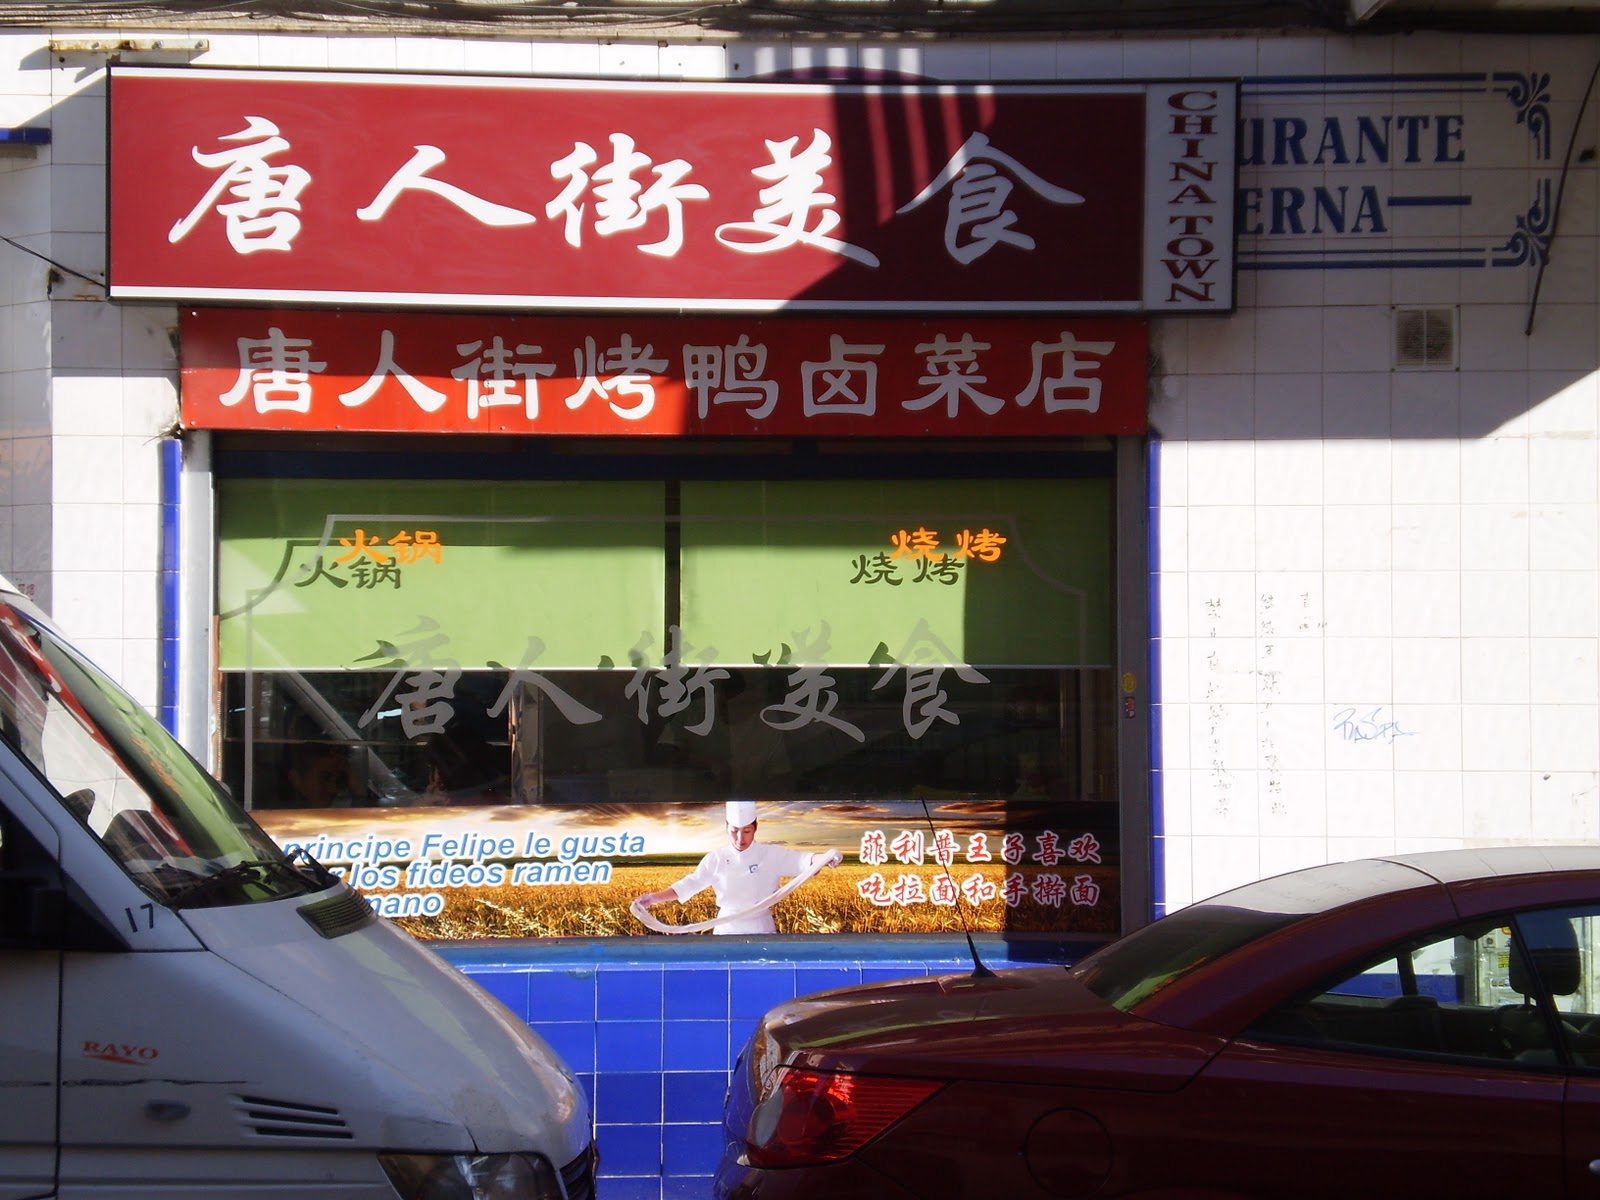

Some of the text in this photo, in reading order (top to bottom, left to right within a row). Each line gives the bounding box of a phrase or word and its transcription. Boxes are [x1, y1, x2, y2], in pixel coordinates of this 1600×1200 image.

[168, 115, 1086, 268] 唐人街美食
[1160, 90, 1220, 303] CHINATOWN
[218, 326, 1116, 420] 唐人街烤鸭卤菜店
[335, 528, 442, 565] 火锅
[890, 526, 1007, 562] 烧烤
[357, 614, 991, 744] 唐人街美食
[421, 832, 515, 862] Felipe
[525, 832, 551, 856] le
[560, 831, 645, 861] gusta
[860, 831, 1101, 866] 菲利普王子喜欢
[350, 861, 398, 887] los
[407, 861, 503, 887] fideos
[513, 863, 610, 884] ramen
[859, 873, 1100, 907] 吃拉面和手擀面
[125, 902, 155, 933] 17
[83, 1040, 160, 1060] RAYO
